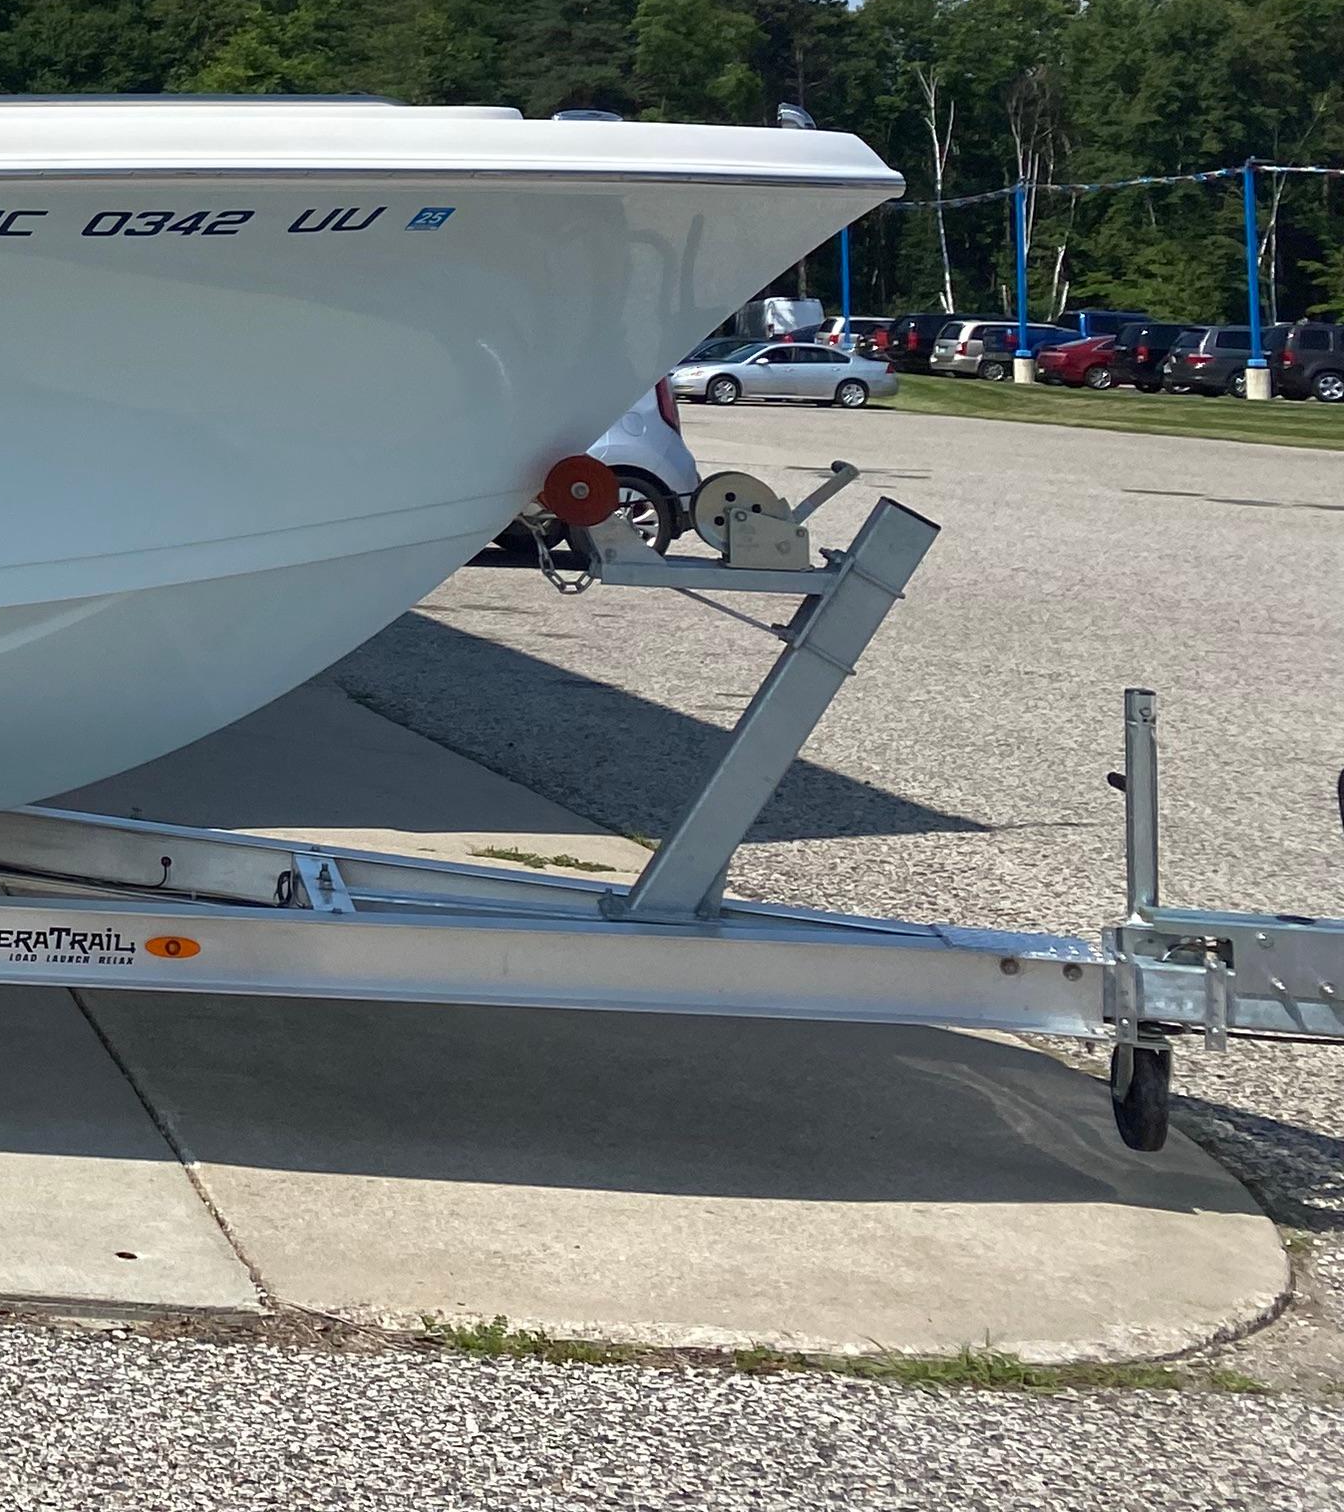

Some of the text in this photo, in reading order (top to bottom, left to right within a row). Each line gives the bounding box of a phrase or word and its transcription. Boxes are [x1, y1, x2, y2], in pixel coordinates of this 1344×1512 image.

[81, 210, 255, 237] 0342
[287, 206, 388, 234] UU
[415, 211, 447, 224] 25
[8, 953, 38, 963] LOAD
[98, 956, 134, 966] RELAX
